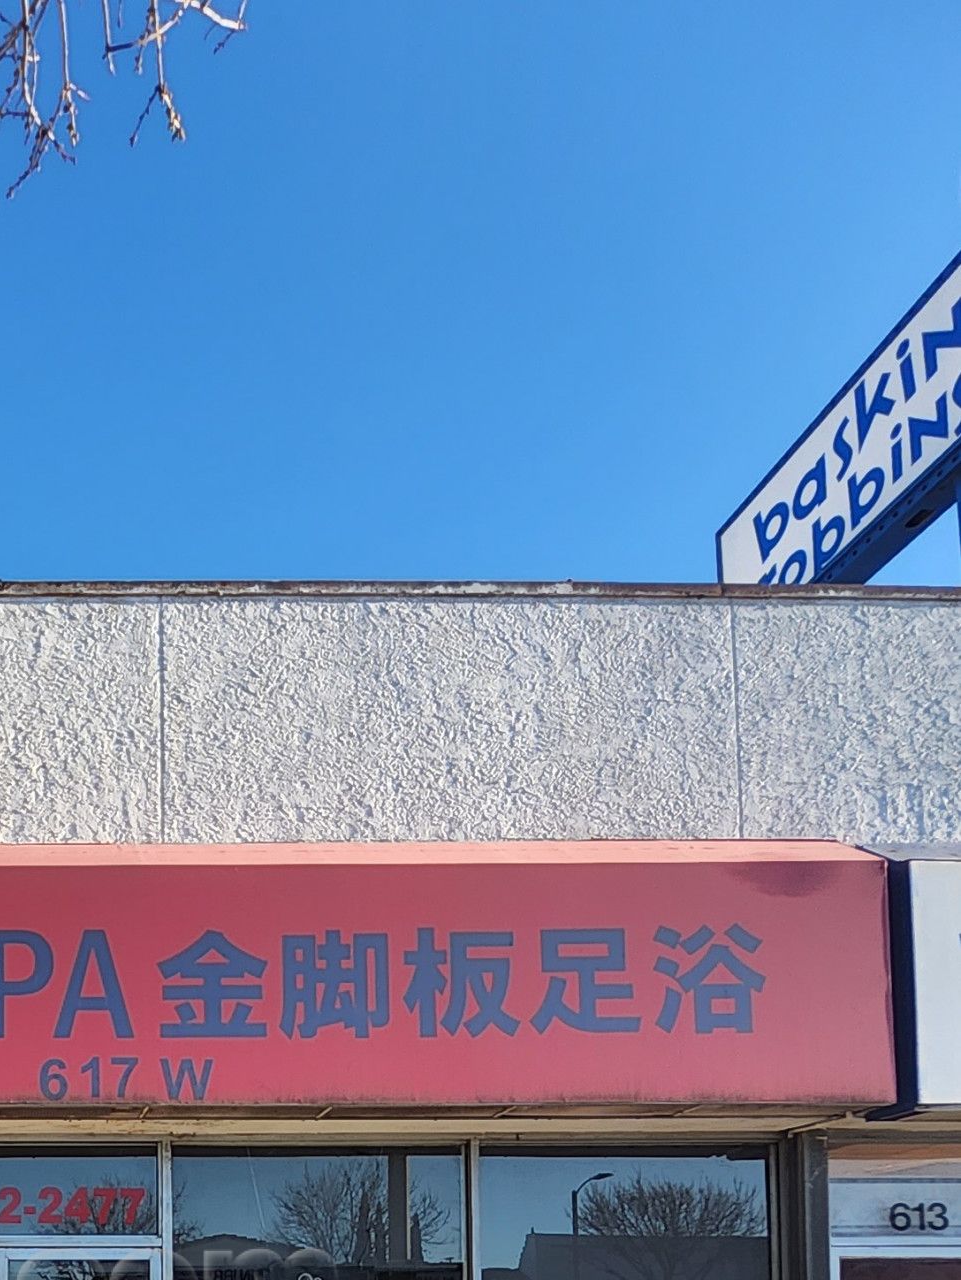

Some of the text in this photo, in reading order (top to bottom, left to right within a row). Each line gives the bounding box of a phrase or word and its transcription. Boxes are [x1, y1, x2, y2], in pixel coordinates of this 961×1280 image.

[156, 923, 766, 1041] 金脚板足浴
[39, 1057, 214, 1101] 617 W
[889, 1202, 950, 1232] 613
